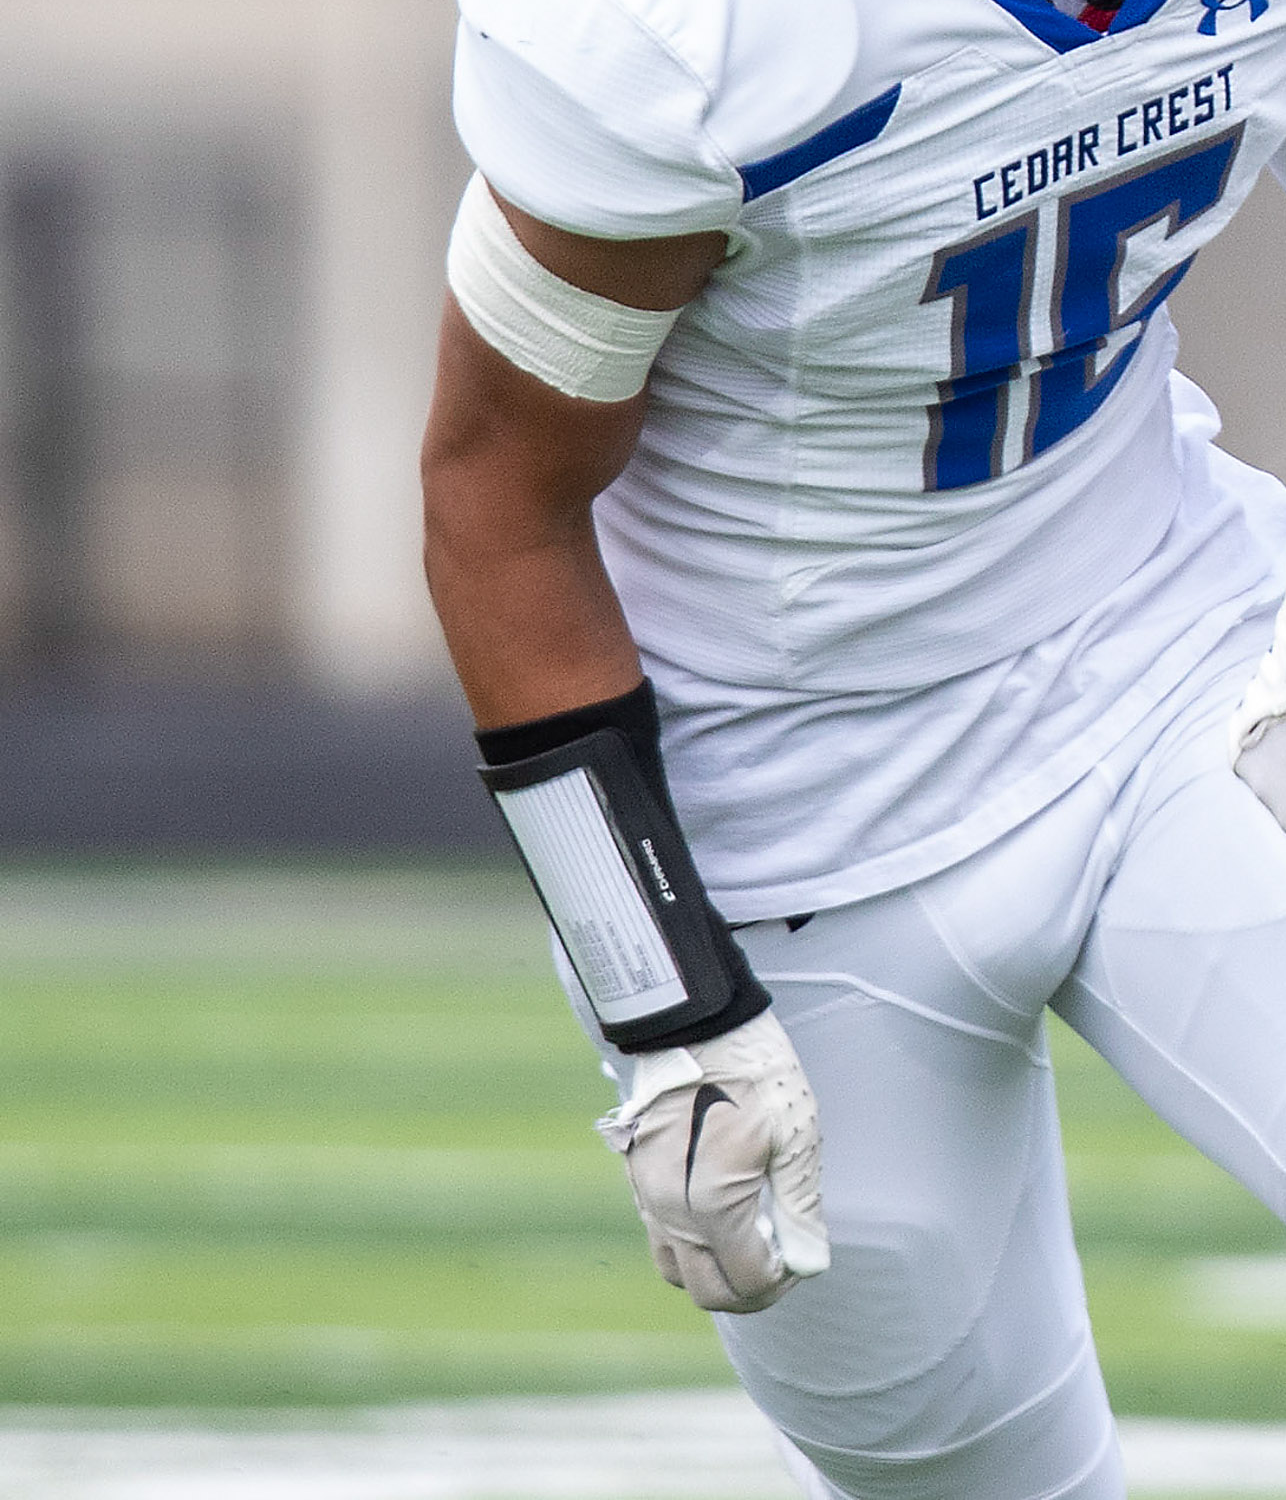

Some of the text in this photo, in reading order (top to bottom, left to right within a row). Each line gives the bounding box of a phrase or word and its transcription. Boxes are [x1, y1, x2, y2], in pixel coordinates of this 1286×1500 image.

[972, 62, 1234, 221] CEDAR CREST
[919, 118, 1248, 493] 16
